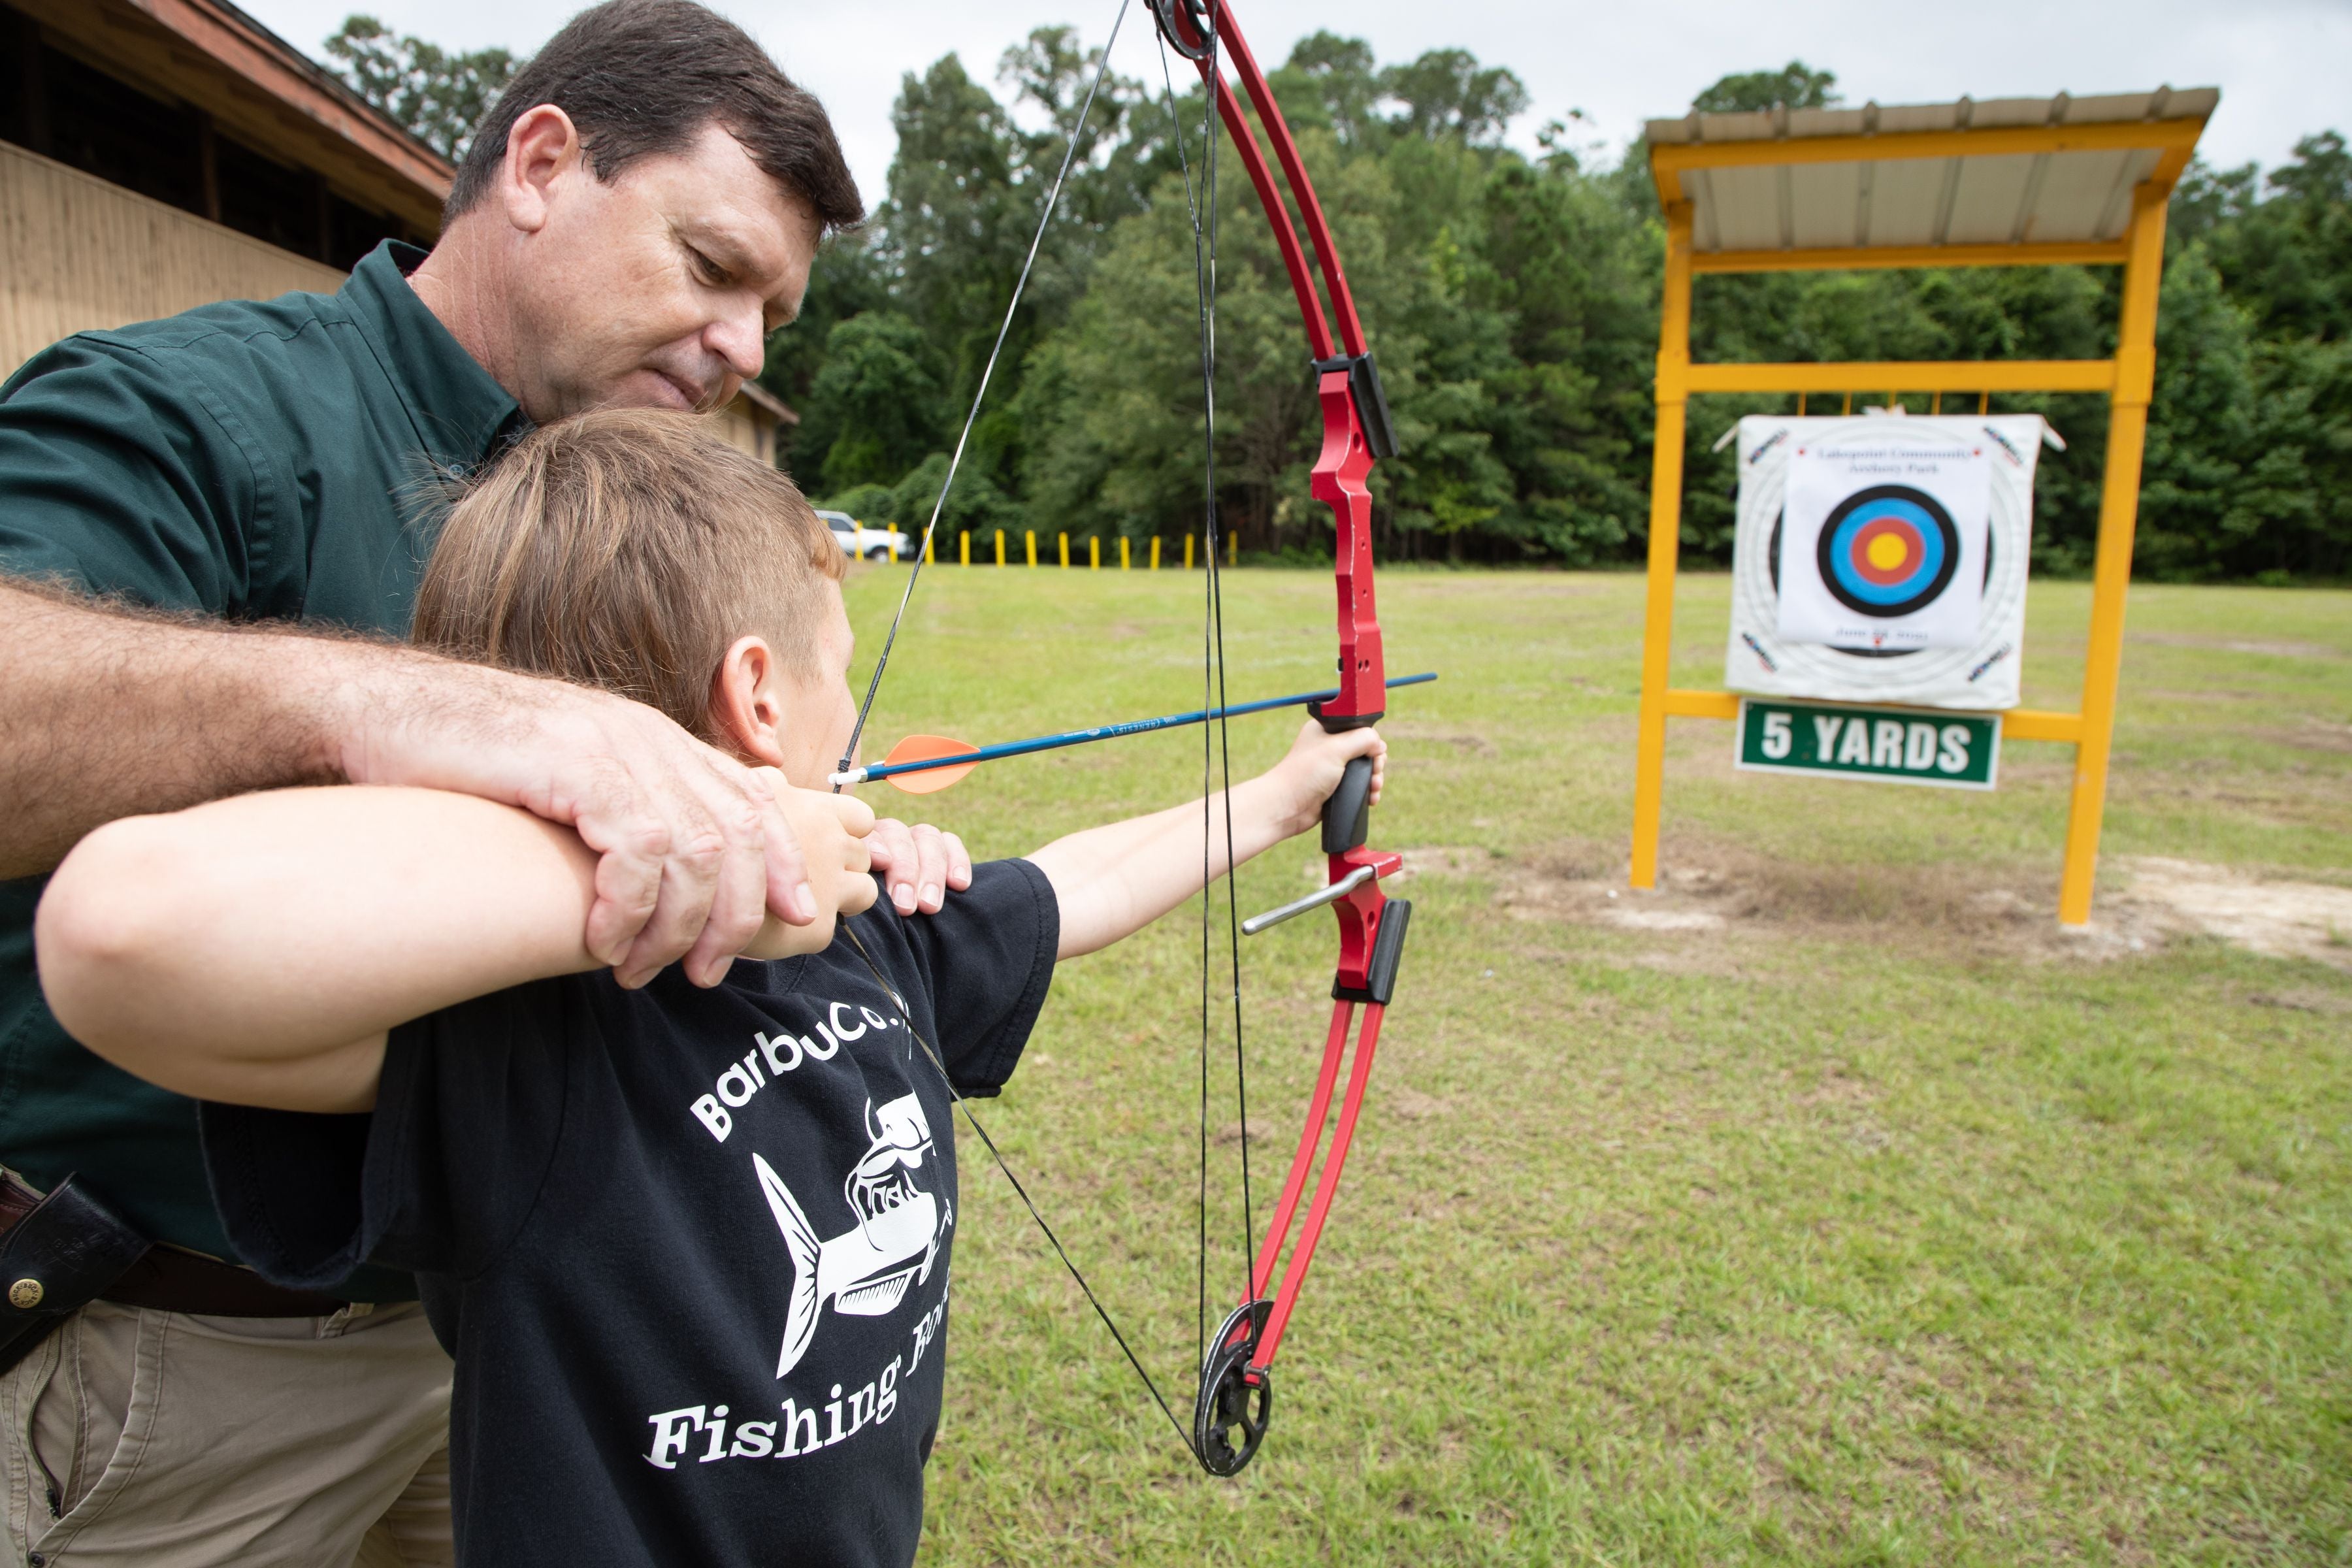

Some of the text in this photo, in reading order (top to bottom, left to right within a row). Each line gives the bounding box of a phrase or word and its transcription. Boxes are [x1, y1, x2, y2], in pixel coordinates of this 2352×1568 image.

[1850, 463, 1939, 476] Archery Park
[1891, 447, 1973, 463] Community
[1760, 711, 1972, 774] 5 YARDS
[642, 1354, 901, 1469] Fishing
